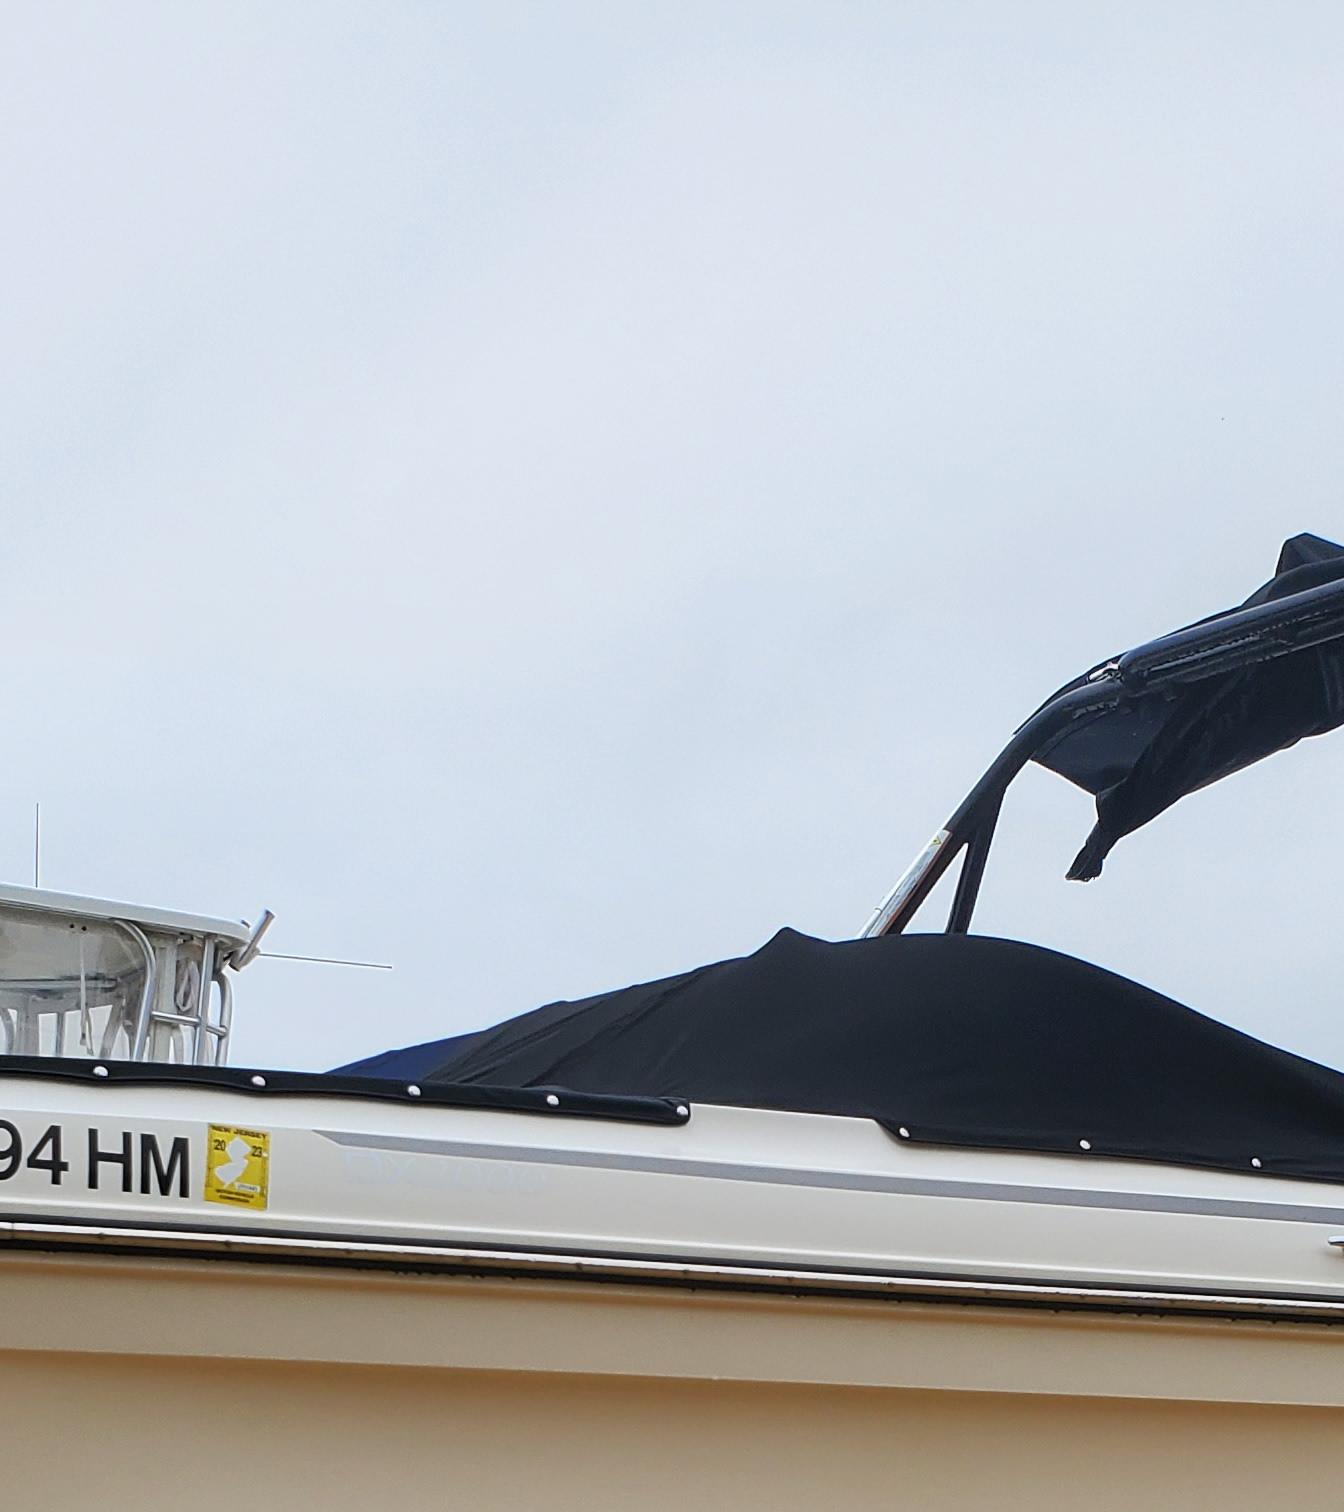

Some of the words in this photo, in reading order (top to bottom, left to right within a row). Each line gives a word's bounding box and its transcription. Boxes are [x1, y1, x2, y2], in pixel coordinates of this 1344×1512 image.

[233, 1128, 267, 1140] JERSEY
[213, 1138, 226, 1152] 20
[251, 1145, 263, 1158] 23
[87, 1127, 190, 1199] HM
